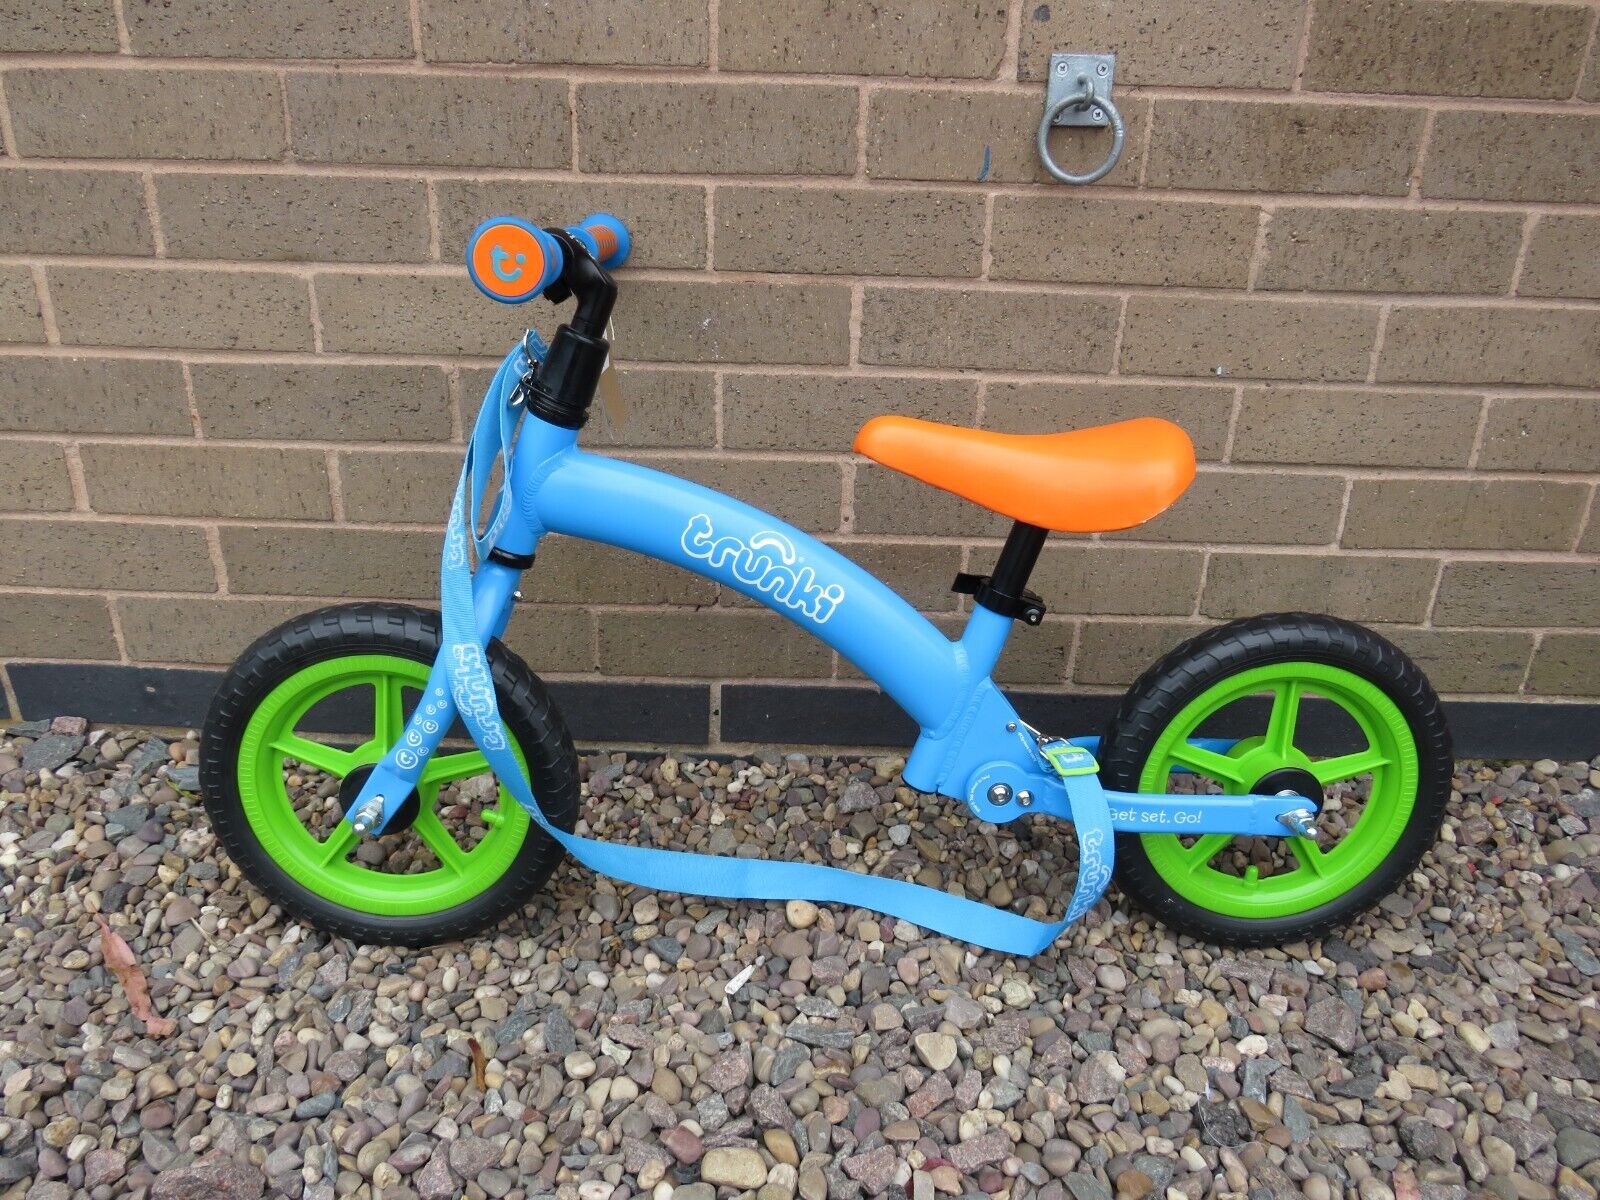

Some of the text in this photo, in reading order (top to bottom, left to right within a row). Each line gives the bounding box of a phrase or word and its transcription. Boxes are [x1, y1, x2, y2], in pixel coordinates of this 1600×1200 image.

[681, 513, 845, 624] trunki
[452, 643, 506, 751] trunki
[1141, 809, 1171, 824] set.
[1174, 810, 1202, 824] Go!
